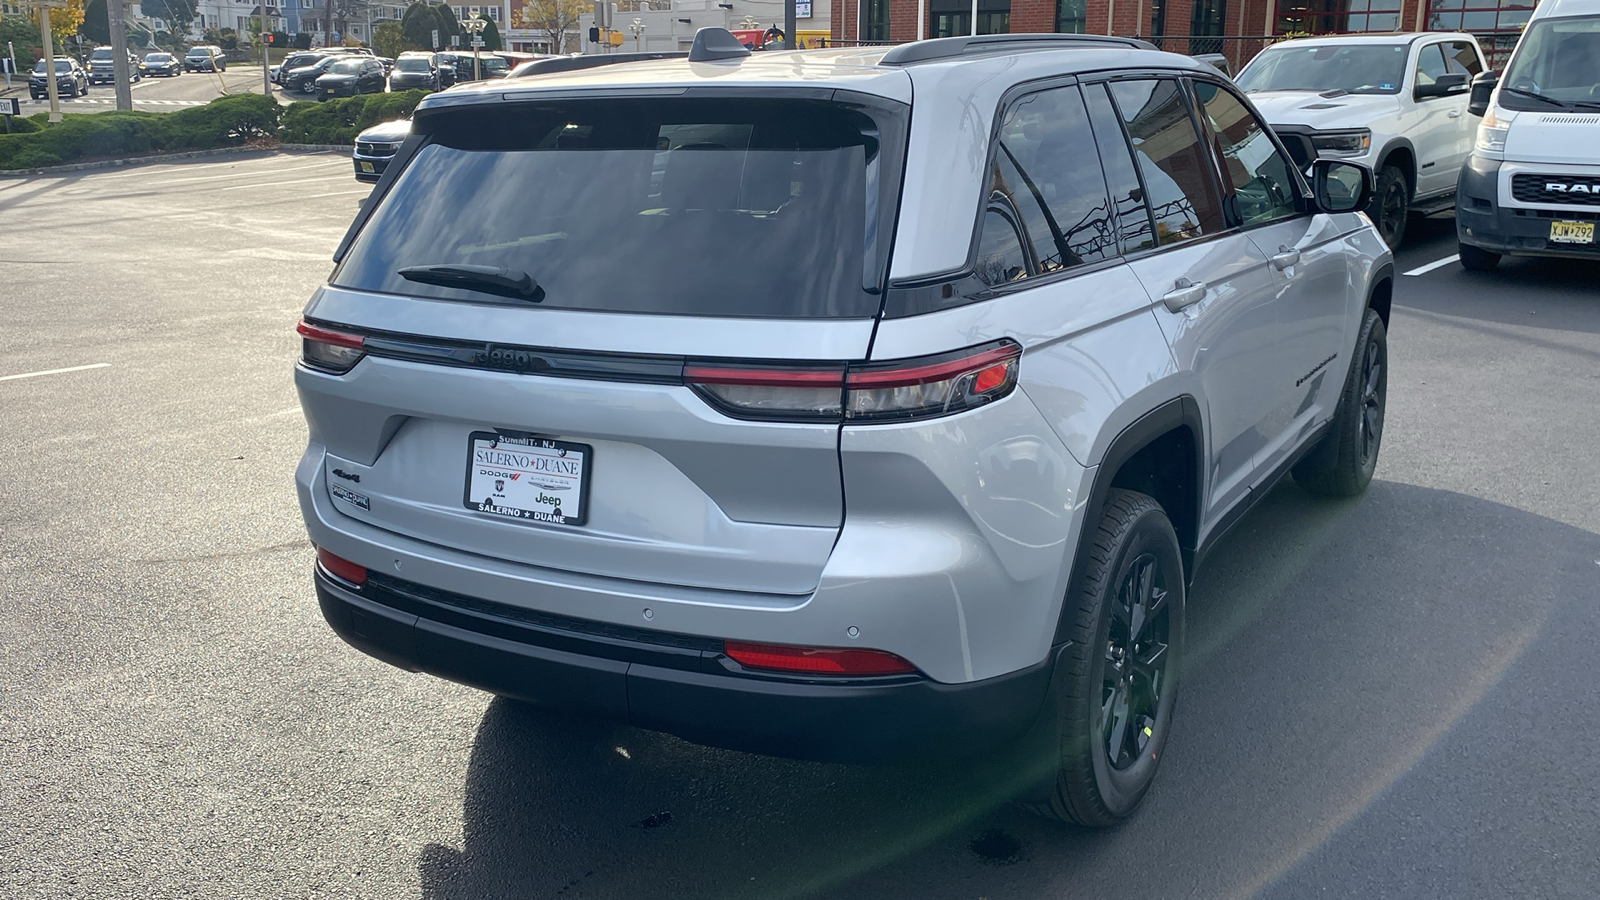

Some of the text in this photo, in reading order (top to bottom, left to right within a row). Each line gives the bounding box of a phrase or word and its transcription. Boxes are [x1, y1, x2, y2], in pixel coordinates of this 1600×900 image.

[475, 343, 530, 372] Jeep
[542, 440, 556, 449] NJ
[476, 450, 579, 475] SALERNO DUANE
[535, 492, 561, 507] Jeep
[478, 503, 565, 524] SALERNO DUANE
